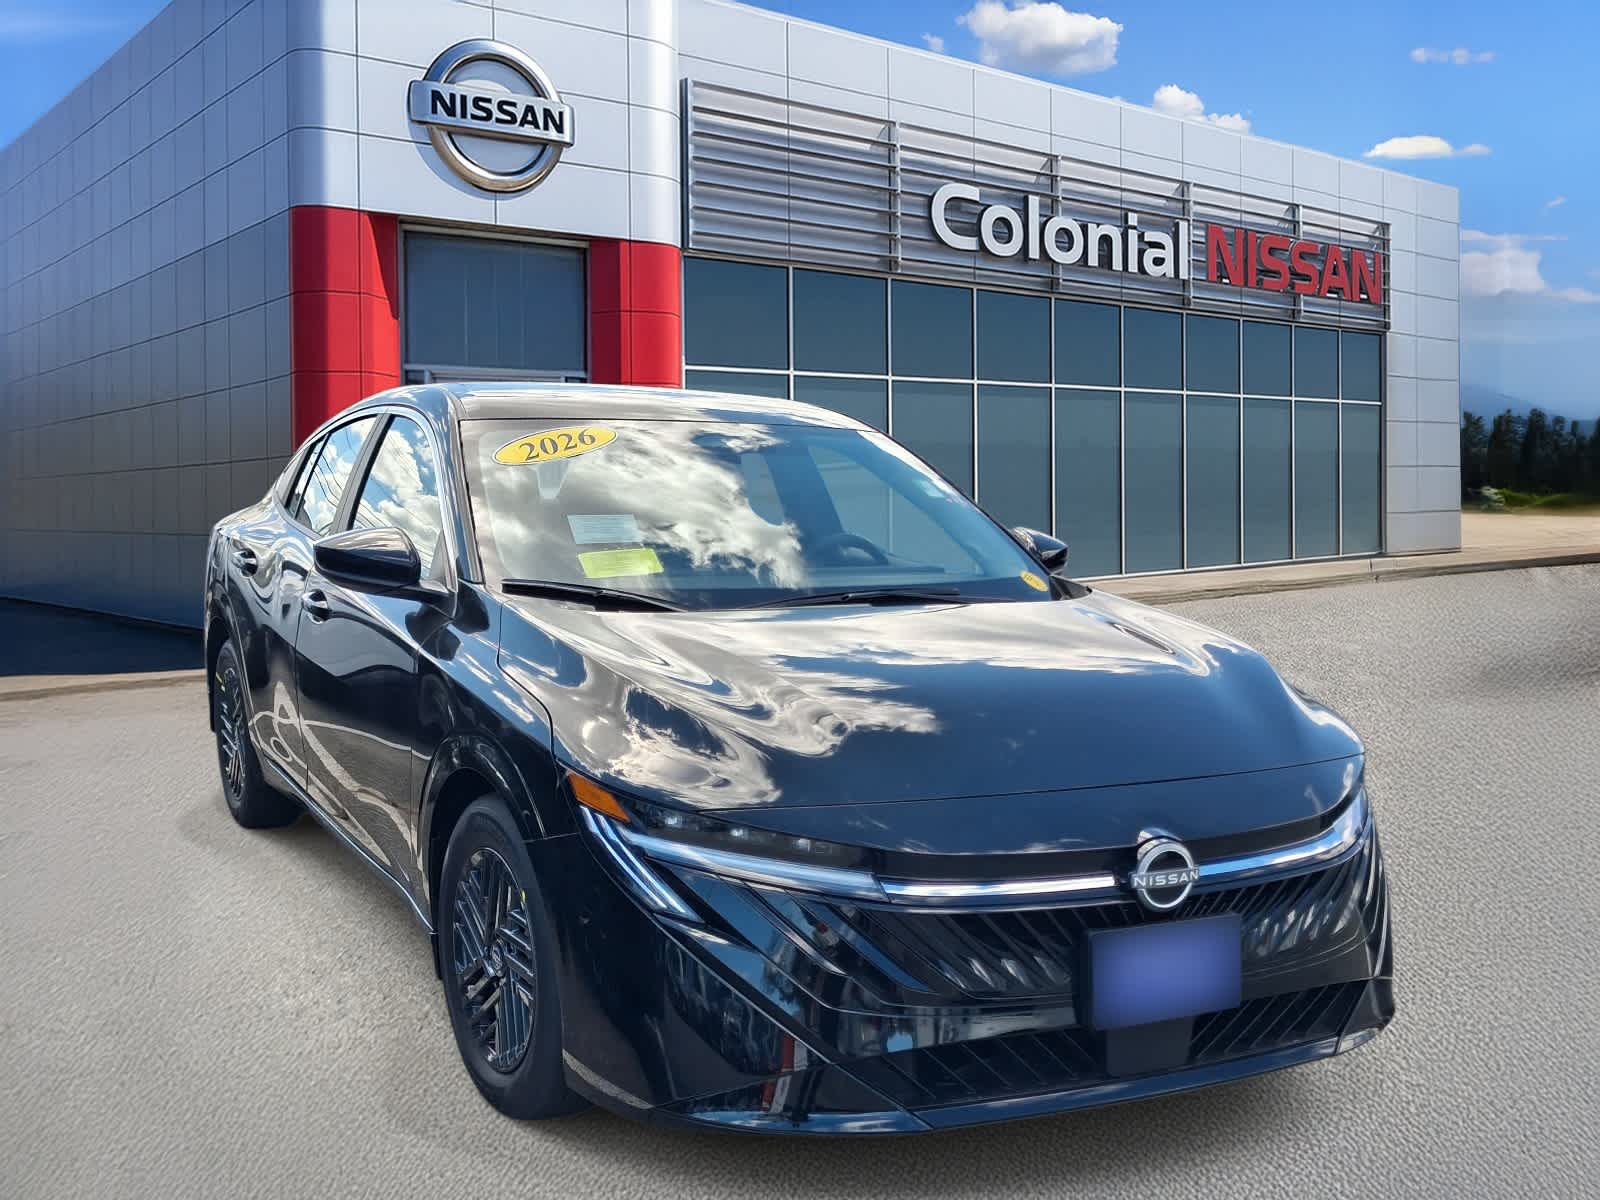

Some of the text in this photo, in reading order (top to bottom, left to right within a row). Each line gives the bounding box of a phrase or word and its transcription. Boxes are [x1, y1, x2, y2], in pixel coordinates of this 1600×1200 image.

[430, 89, 564, 134] NISSAN
[929, 182, 1382, 304] Colonial NISSAN
[519, 428, 596, 461] 2026
[1133, 869, 1199, 887] NISSAN
